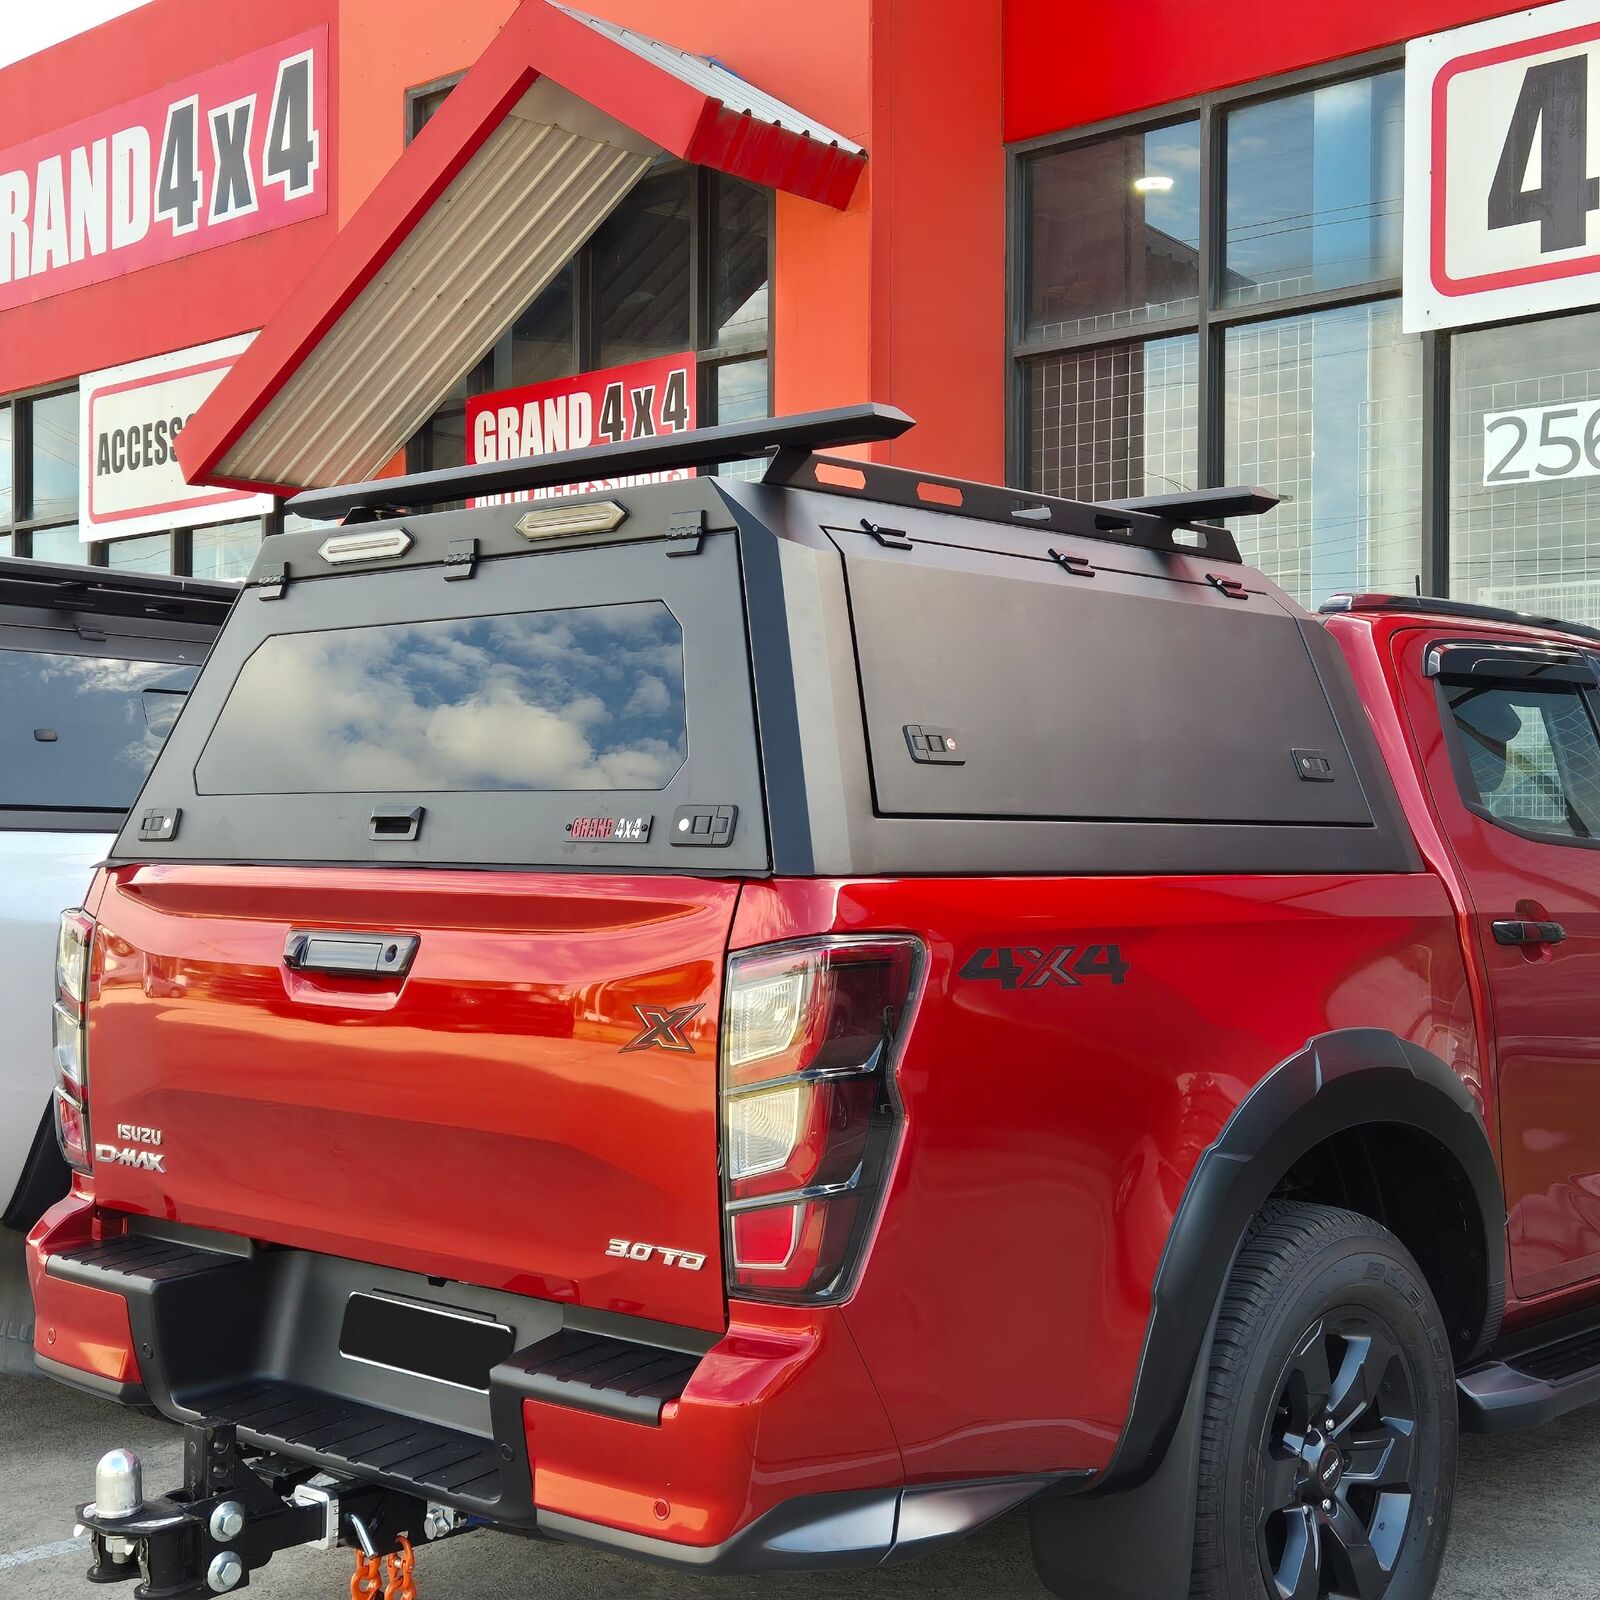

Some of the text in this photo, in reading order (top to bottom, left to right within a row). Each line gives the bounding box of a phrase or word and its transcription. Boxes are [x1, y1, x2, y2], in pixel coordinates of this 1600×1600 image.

[154, 48, 319, 237] 4x4
[1487, 53, 1600, 254] 4
[474, 368, 690, 465] GRAND 4x4
[571, 817, 615, 839] GRAND
[117, 1123, 162, 1146] ISUZU
